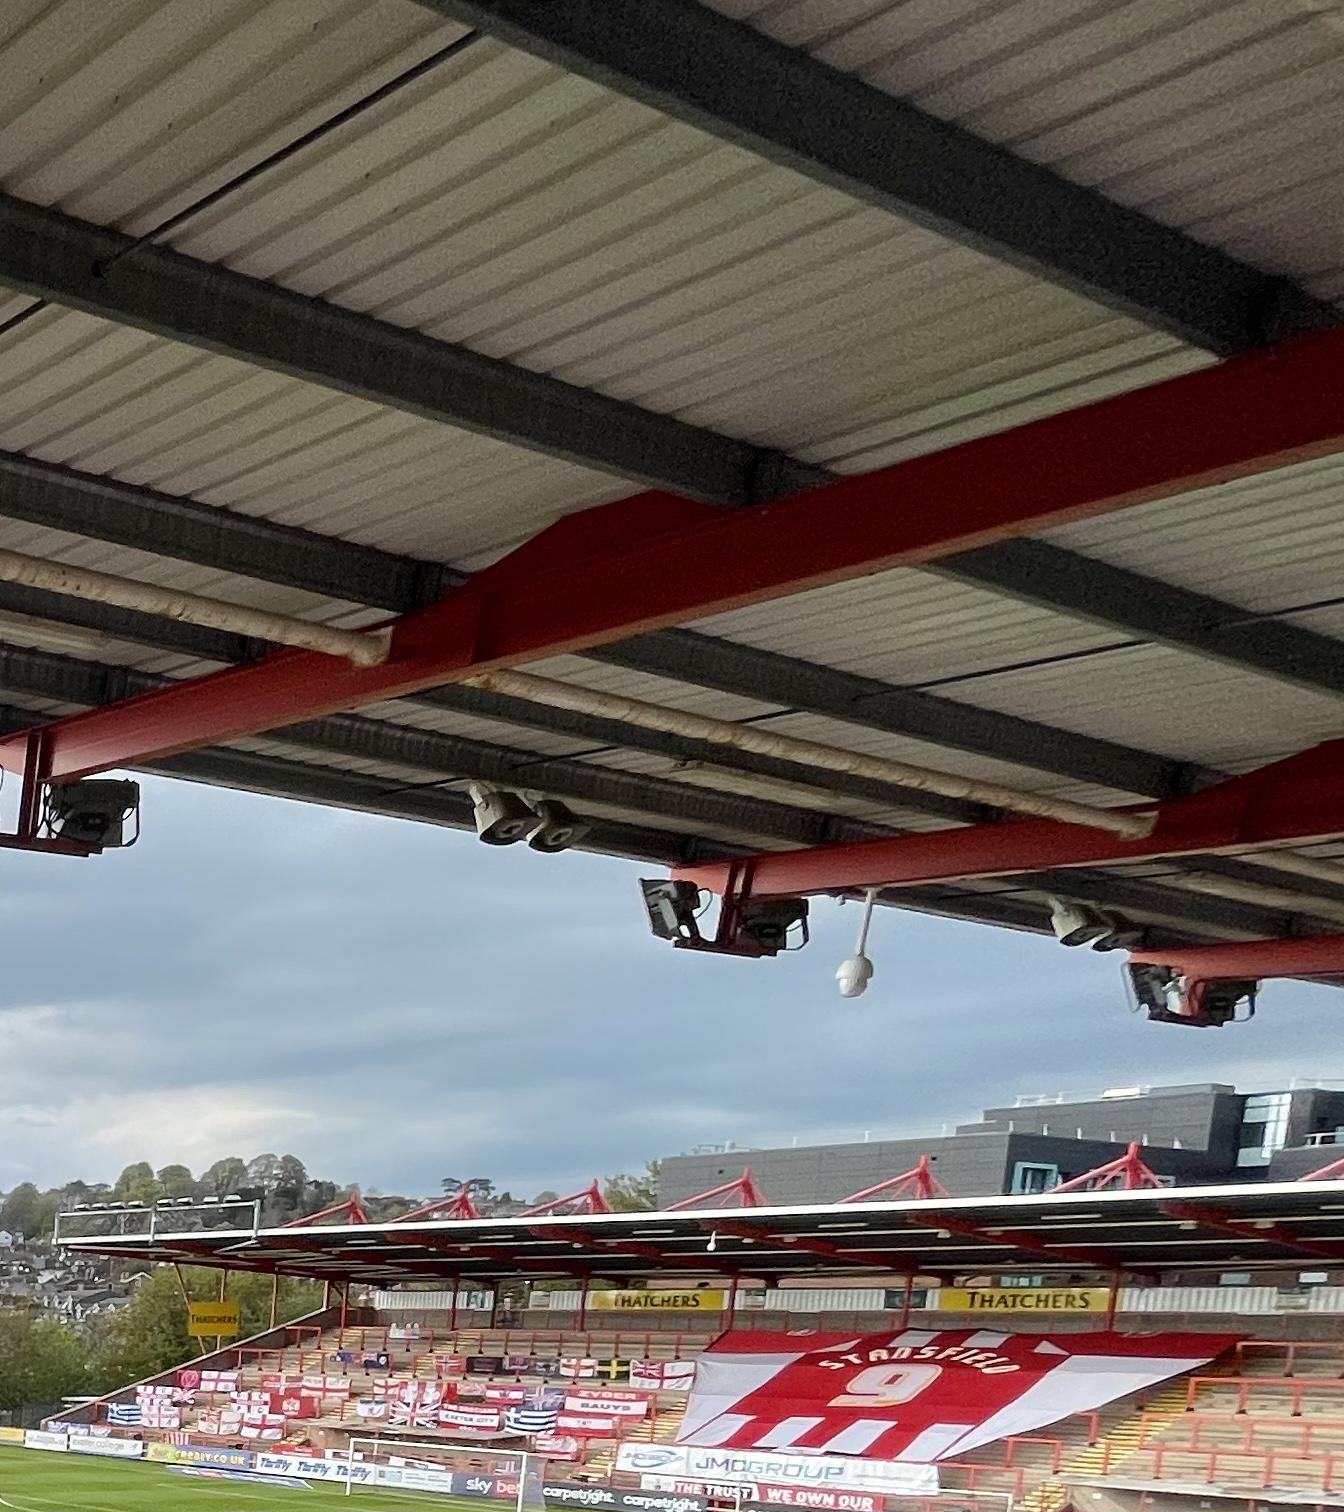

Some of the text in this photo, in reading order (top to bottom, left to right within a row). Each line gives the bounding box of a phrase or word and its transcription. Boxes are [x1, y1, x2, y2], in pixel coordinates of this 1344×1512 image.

[966, 1290, 1090, 1310] THATCHERS
[826, 1362, 944, 1408] 9
[466, 1477, 493, 1494] sky
[675, 1482, 752, 1500] THE TRUST
[767, 1489, 875, 1510] WE OWN OUR
